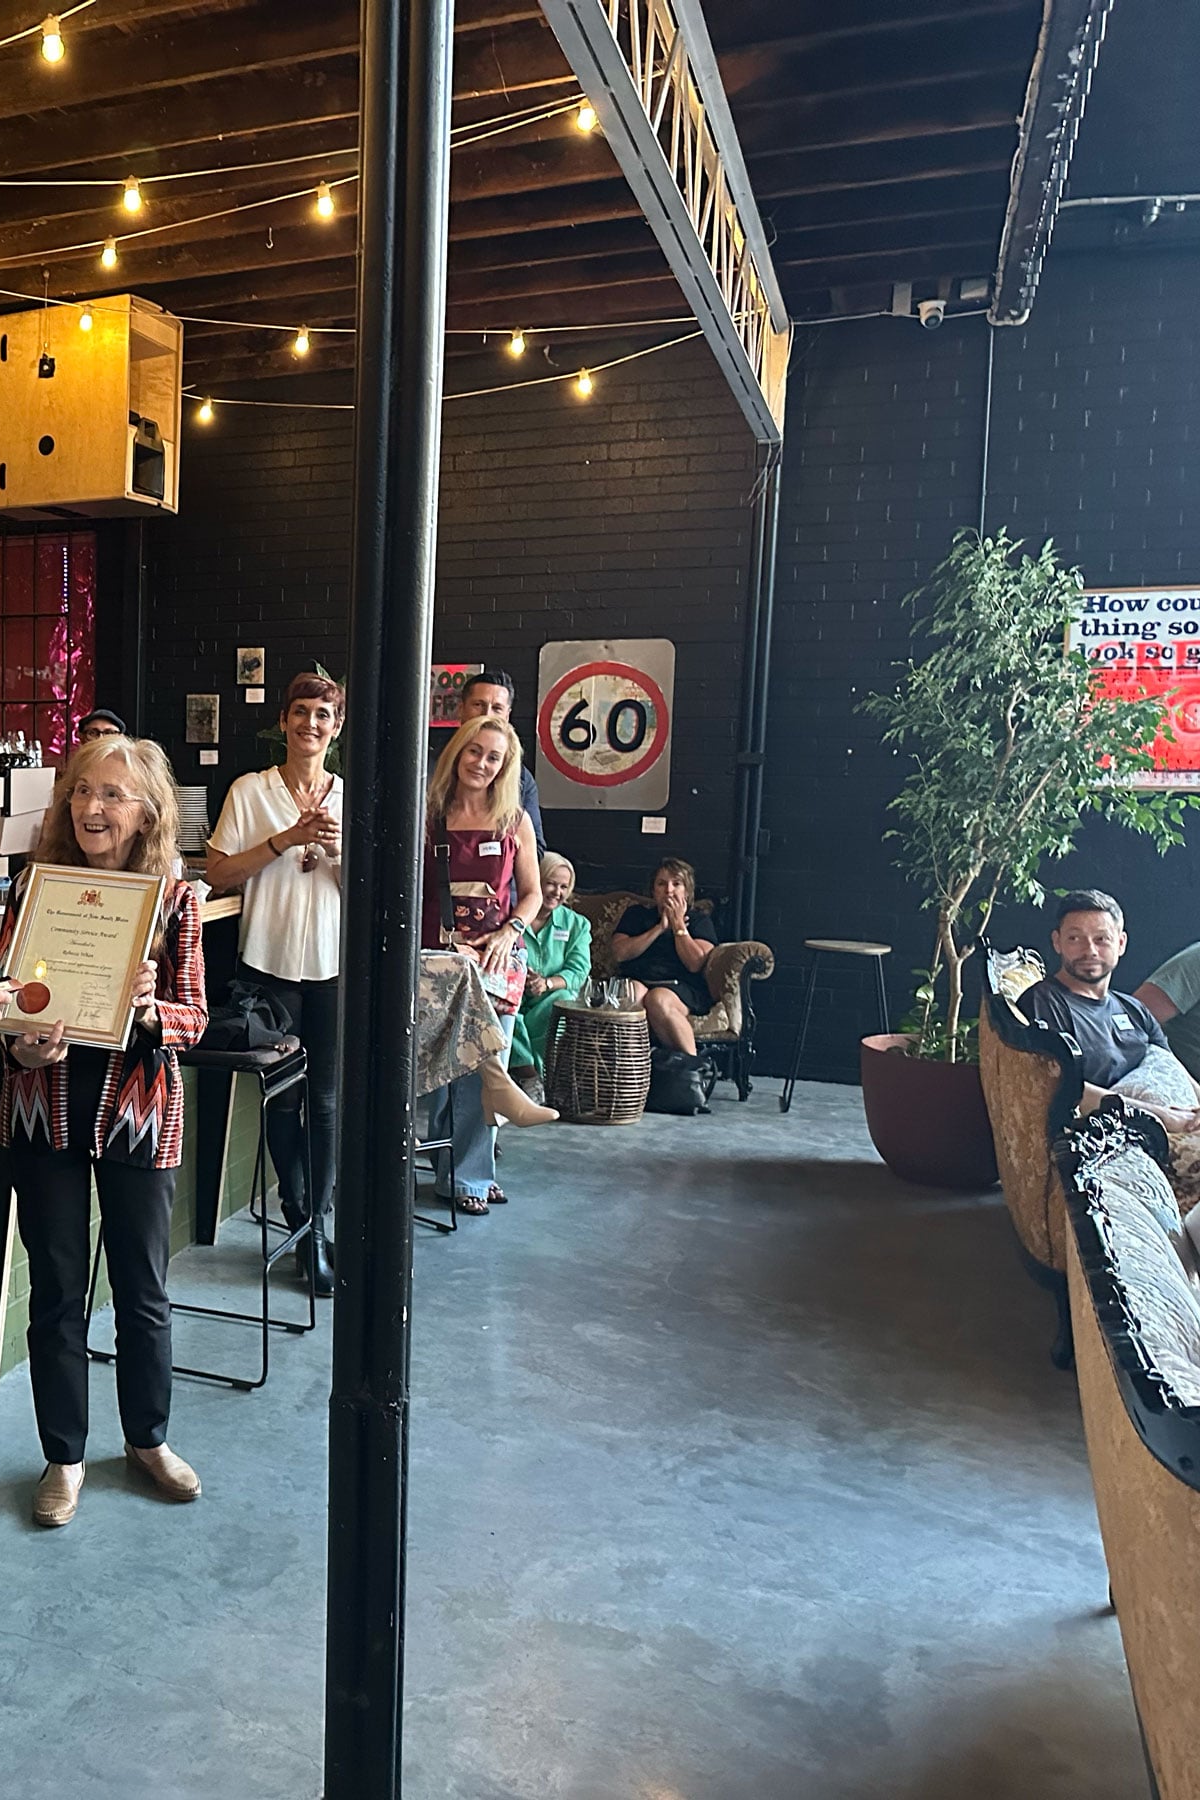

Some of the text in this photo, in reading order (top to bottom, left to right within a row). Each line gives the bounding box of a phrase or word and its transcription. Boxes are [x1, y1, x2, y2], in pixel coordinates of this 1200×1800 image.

[1083, 595, 1150, 613] How
[1079, 618, 1199, 641] thing so
[1076, 641, 1134, 661] look
[1146, 646, 1173, 660] so
[560, 698, 647, 753] 60
